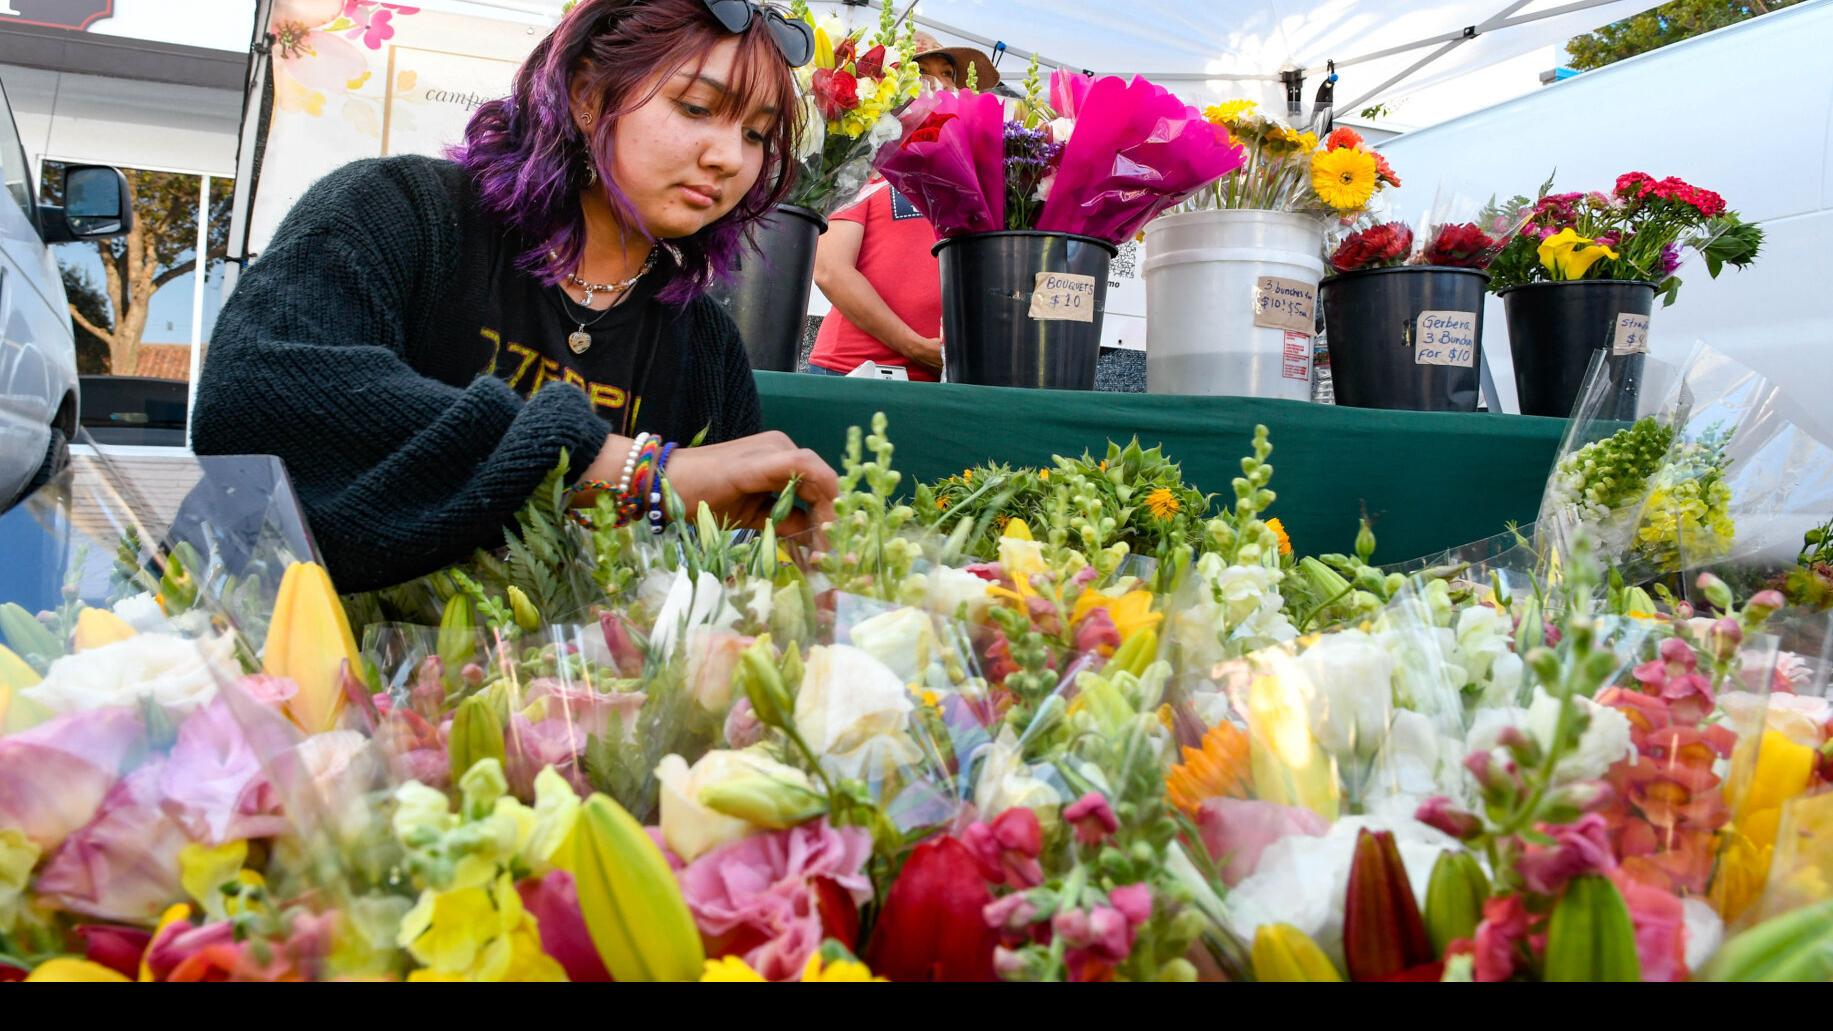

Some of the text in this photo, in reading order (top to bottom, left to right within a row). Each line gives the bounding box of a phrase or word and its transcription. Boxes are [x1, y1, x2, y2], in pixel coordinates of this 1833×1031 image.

[1046, 277, 1094, 296] BOUQUETS
[1264, 280, 1273, 290] 3
[1423, 315, 1471, 331] Gerbera
[1423, 332, 1434, 344] 3
[1448, 347, 1470, 362] $10
